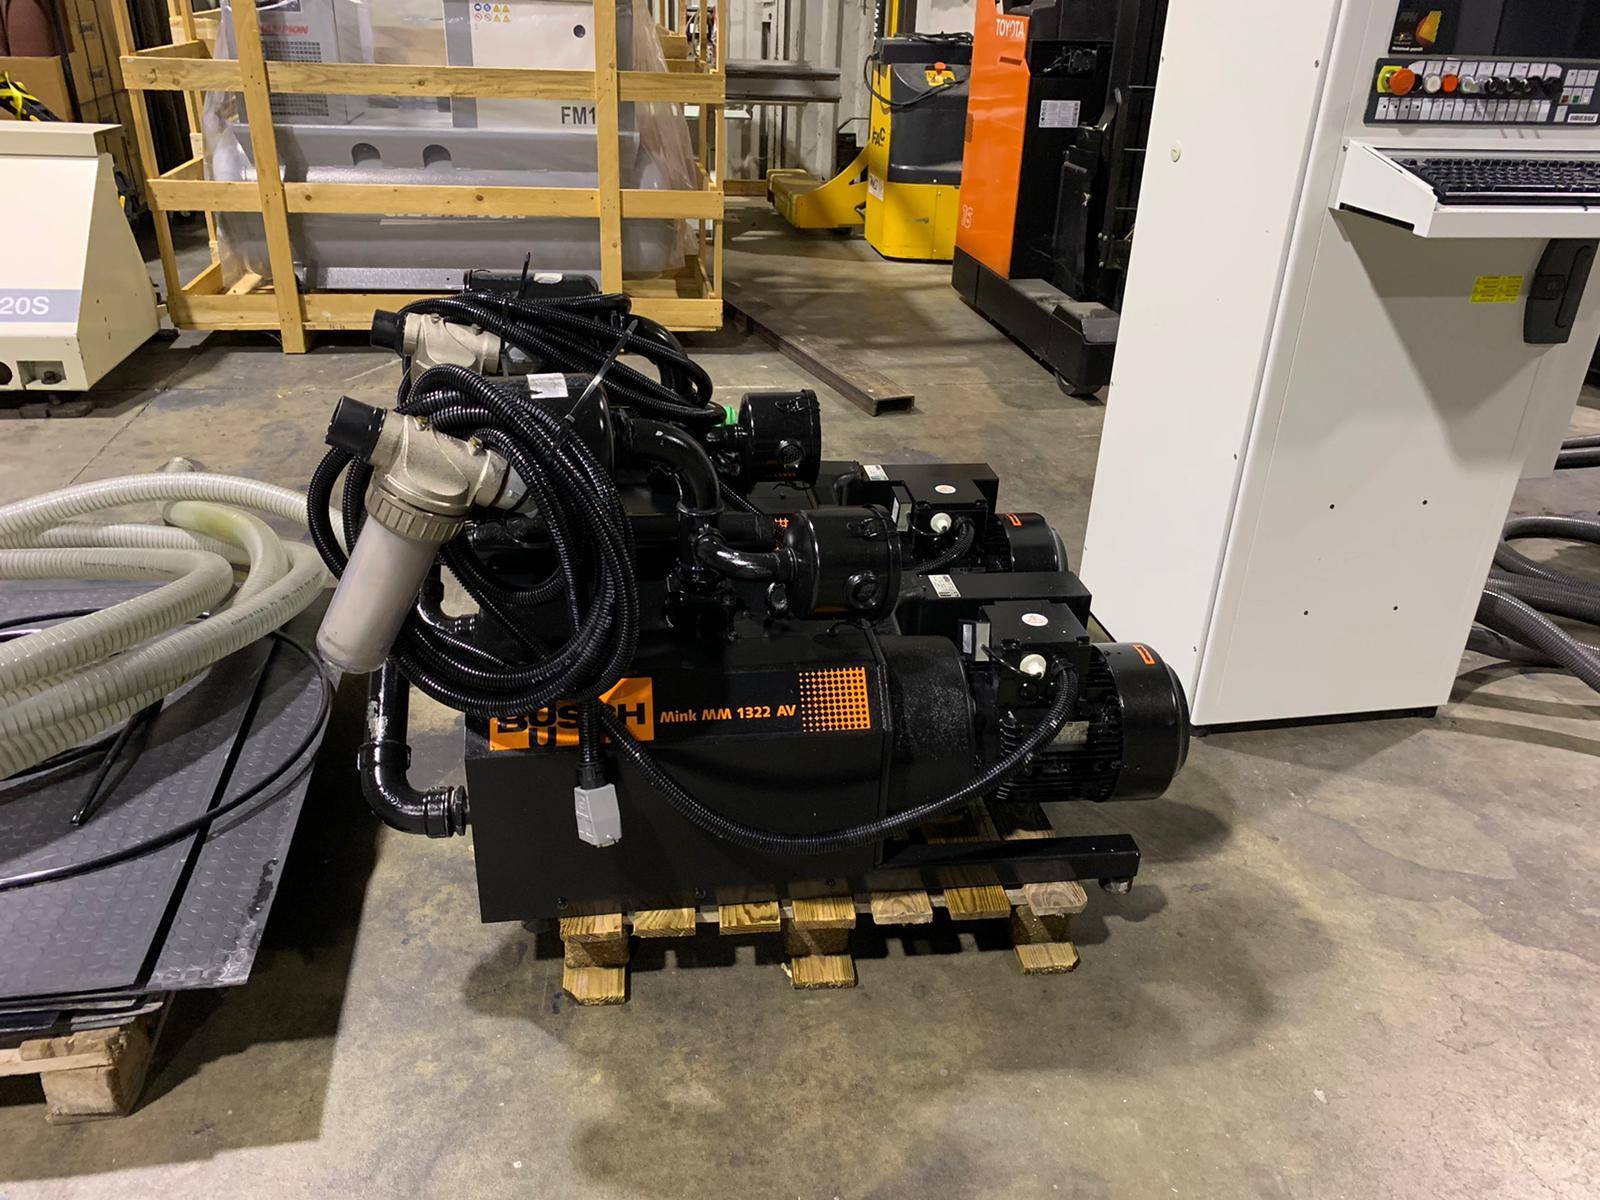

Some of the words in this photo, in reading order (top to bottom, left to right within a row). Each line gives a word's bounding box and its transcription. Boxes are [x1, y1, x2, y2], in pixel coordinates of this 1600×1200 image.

[996, 18, 1024, 38] TOYOTA
[0, 296, 50, 315] 20S
[660, 709, 697, 723] Mink
[701, 707, 732, 721] MM
[736, 705, 771, 719] 1322
[776, 704, 796, 717] AV
